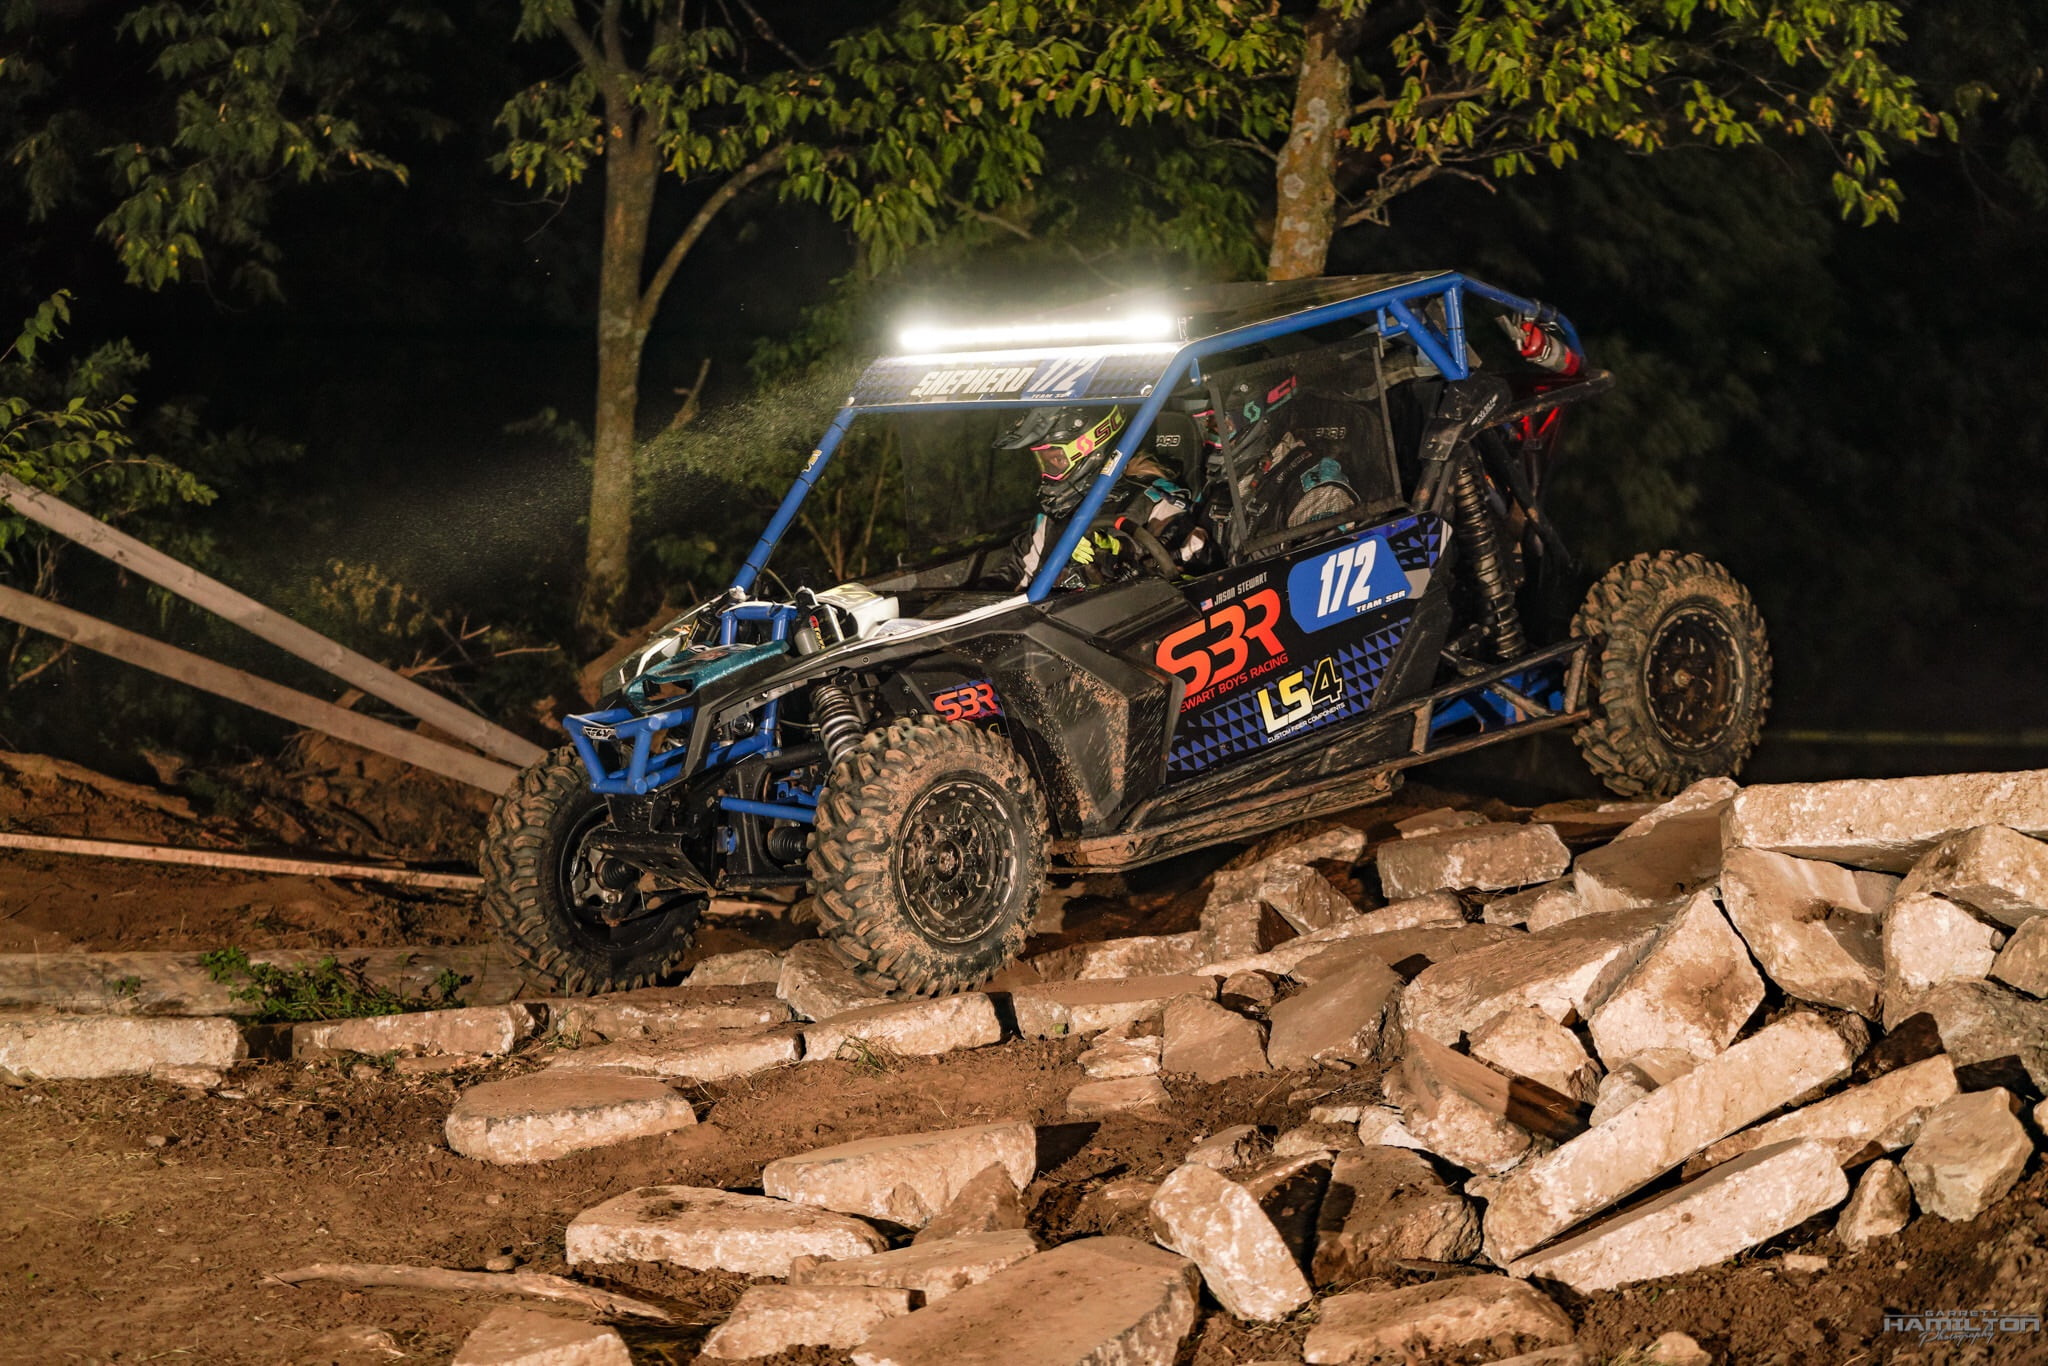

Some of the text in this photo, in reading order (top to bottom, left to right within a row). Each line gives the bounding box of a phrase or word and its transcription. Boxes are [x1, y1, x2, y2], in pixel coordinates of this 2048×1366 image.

[910, 367, 1036, 396] SHEPHERD
[1026, 356, 1099, 393] 172
[1214, 571, 1268, 606] JASON STEWART
[1317, 540, 1377, 618] 172
[1356, 590, 1406, 613] TEAM SBR
[1218, 672, 1248, 694] BOYS
[1249, 653, 1289, 679] RACING
[1257, 656, 1343, 734] LS4
[1267, 728, 1292, 744] CUSTOM
[1307, 702, 1346, 724] COMPONENTS
